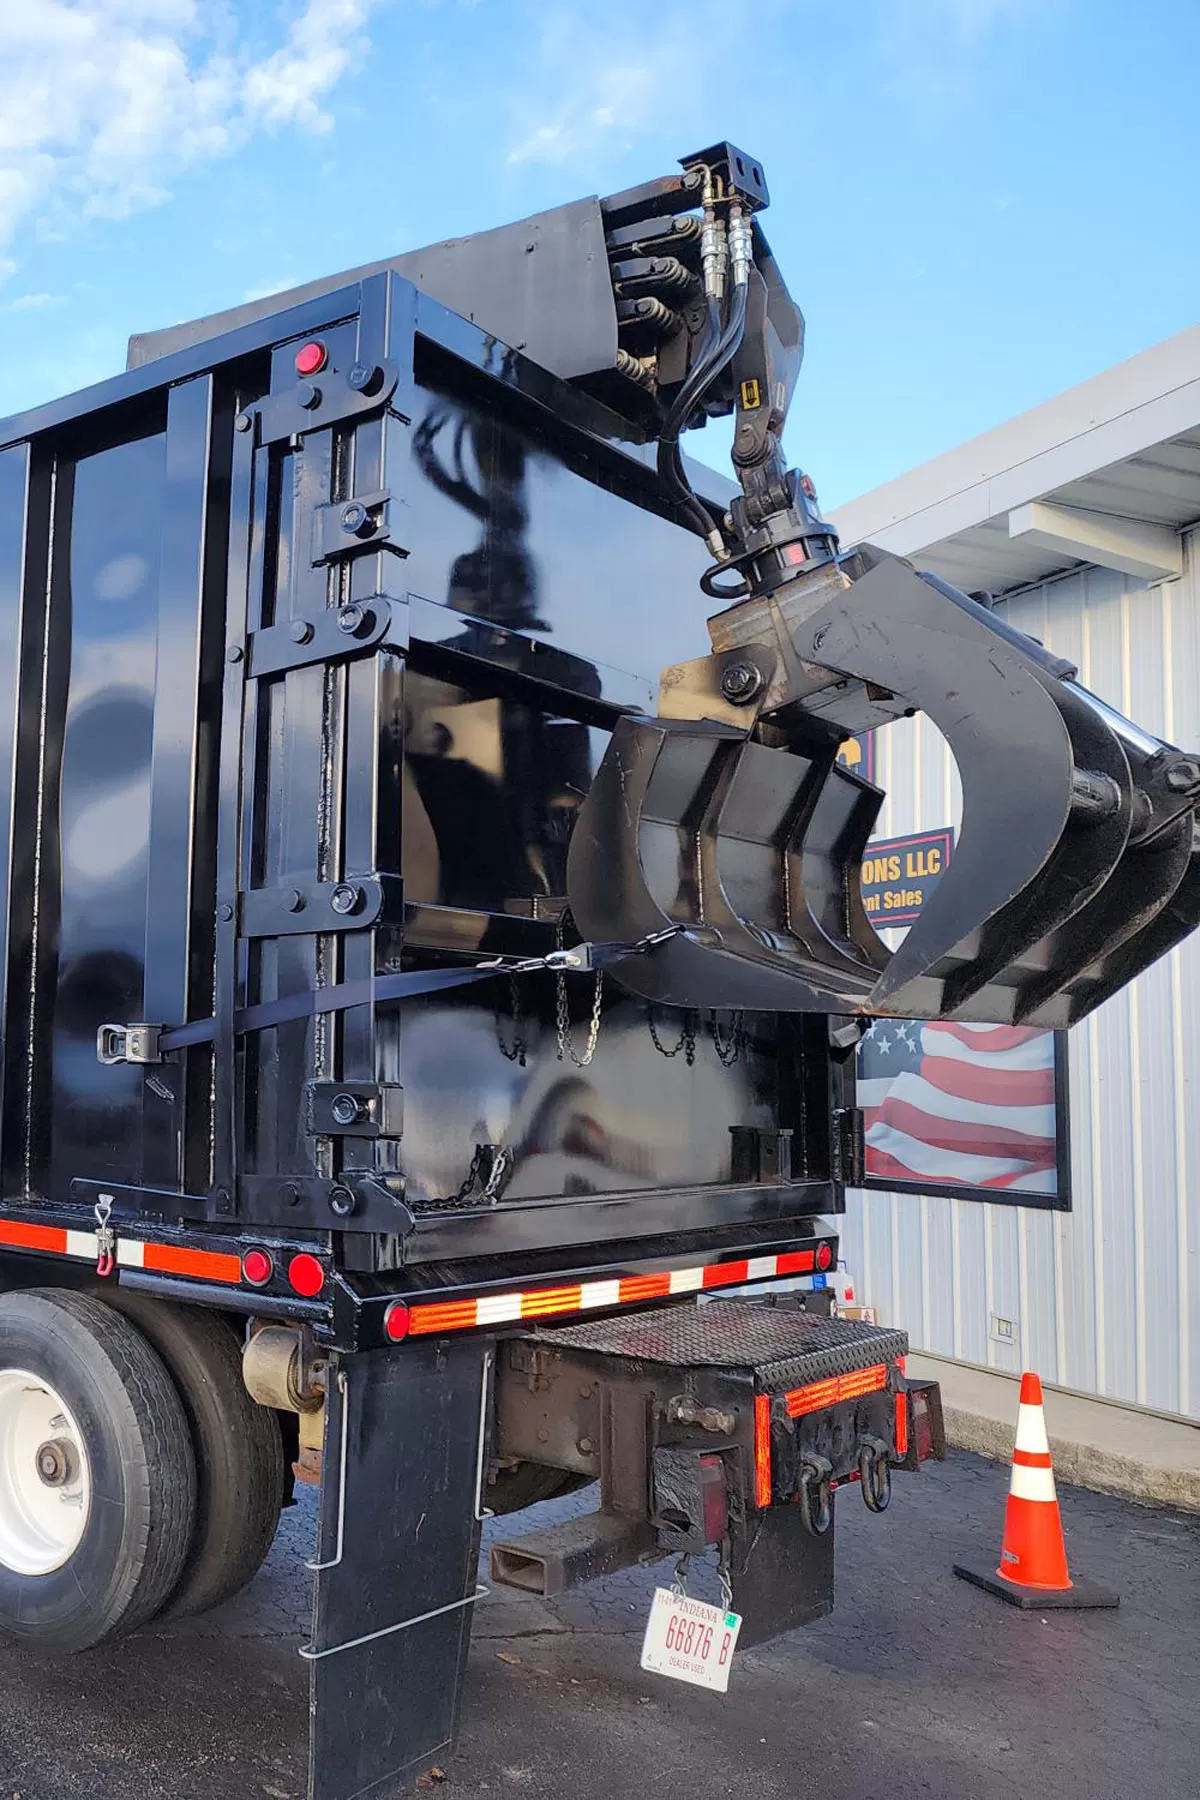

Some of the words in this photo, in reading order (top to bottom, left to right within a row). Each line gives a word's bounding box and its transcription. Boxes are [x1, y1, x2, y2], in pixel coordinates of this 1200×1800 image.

[862, 856, 901, 885] ONS
[906, 849, 941, 878] LLC
[883, 890, 923, 909] Sales
[679, 1600, 718, 1623] INDIANA
[665, 1615, 714, 1660] 66876
[719, 1632, 731, 1665] B
